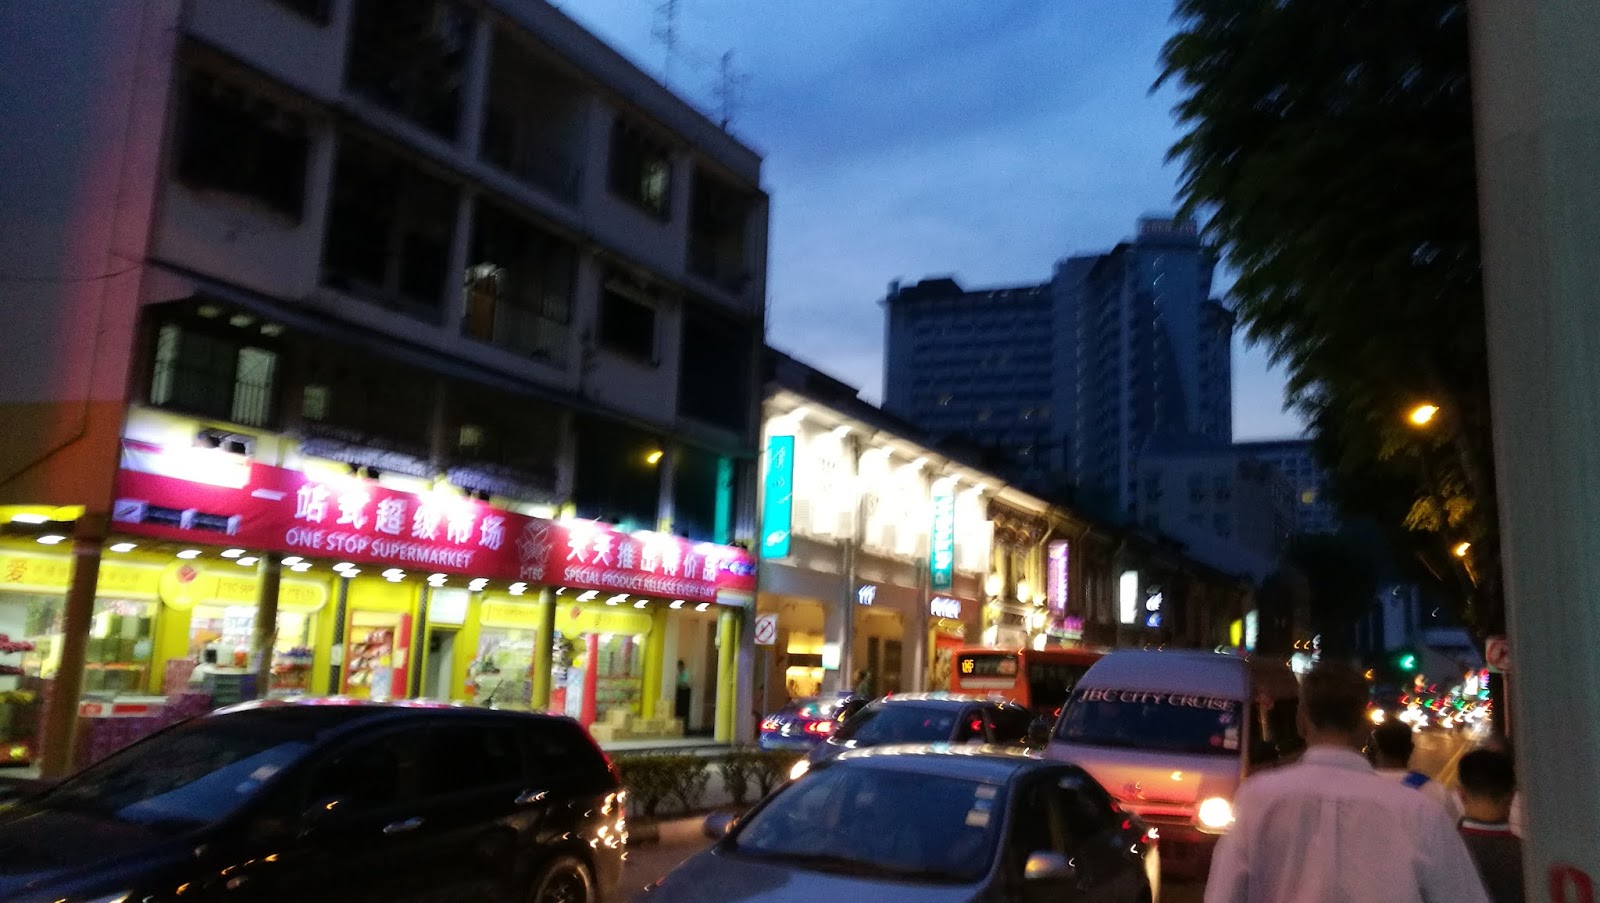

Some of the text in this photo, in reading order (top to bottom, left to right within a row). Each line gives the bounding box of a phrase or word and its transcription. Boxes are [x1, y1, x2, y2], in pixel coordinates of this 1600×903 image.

[285, 529, 475, 568] ONE STOP SUPERMARKET
[564, 566, 600, 585] SPECIAL
[602, 571, 643, 591] PRODUCT
[643, 576, 675, 594] RELEASE
[1078, 688, 1236, 712] JBC CITY CRUISE
